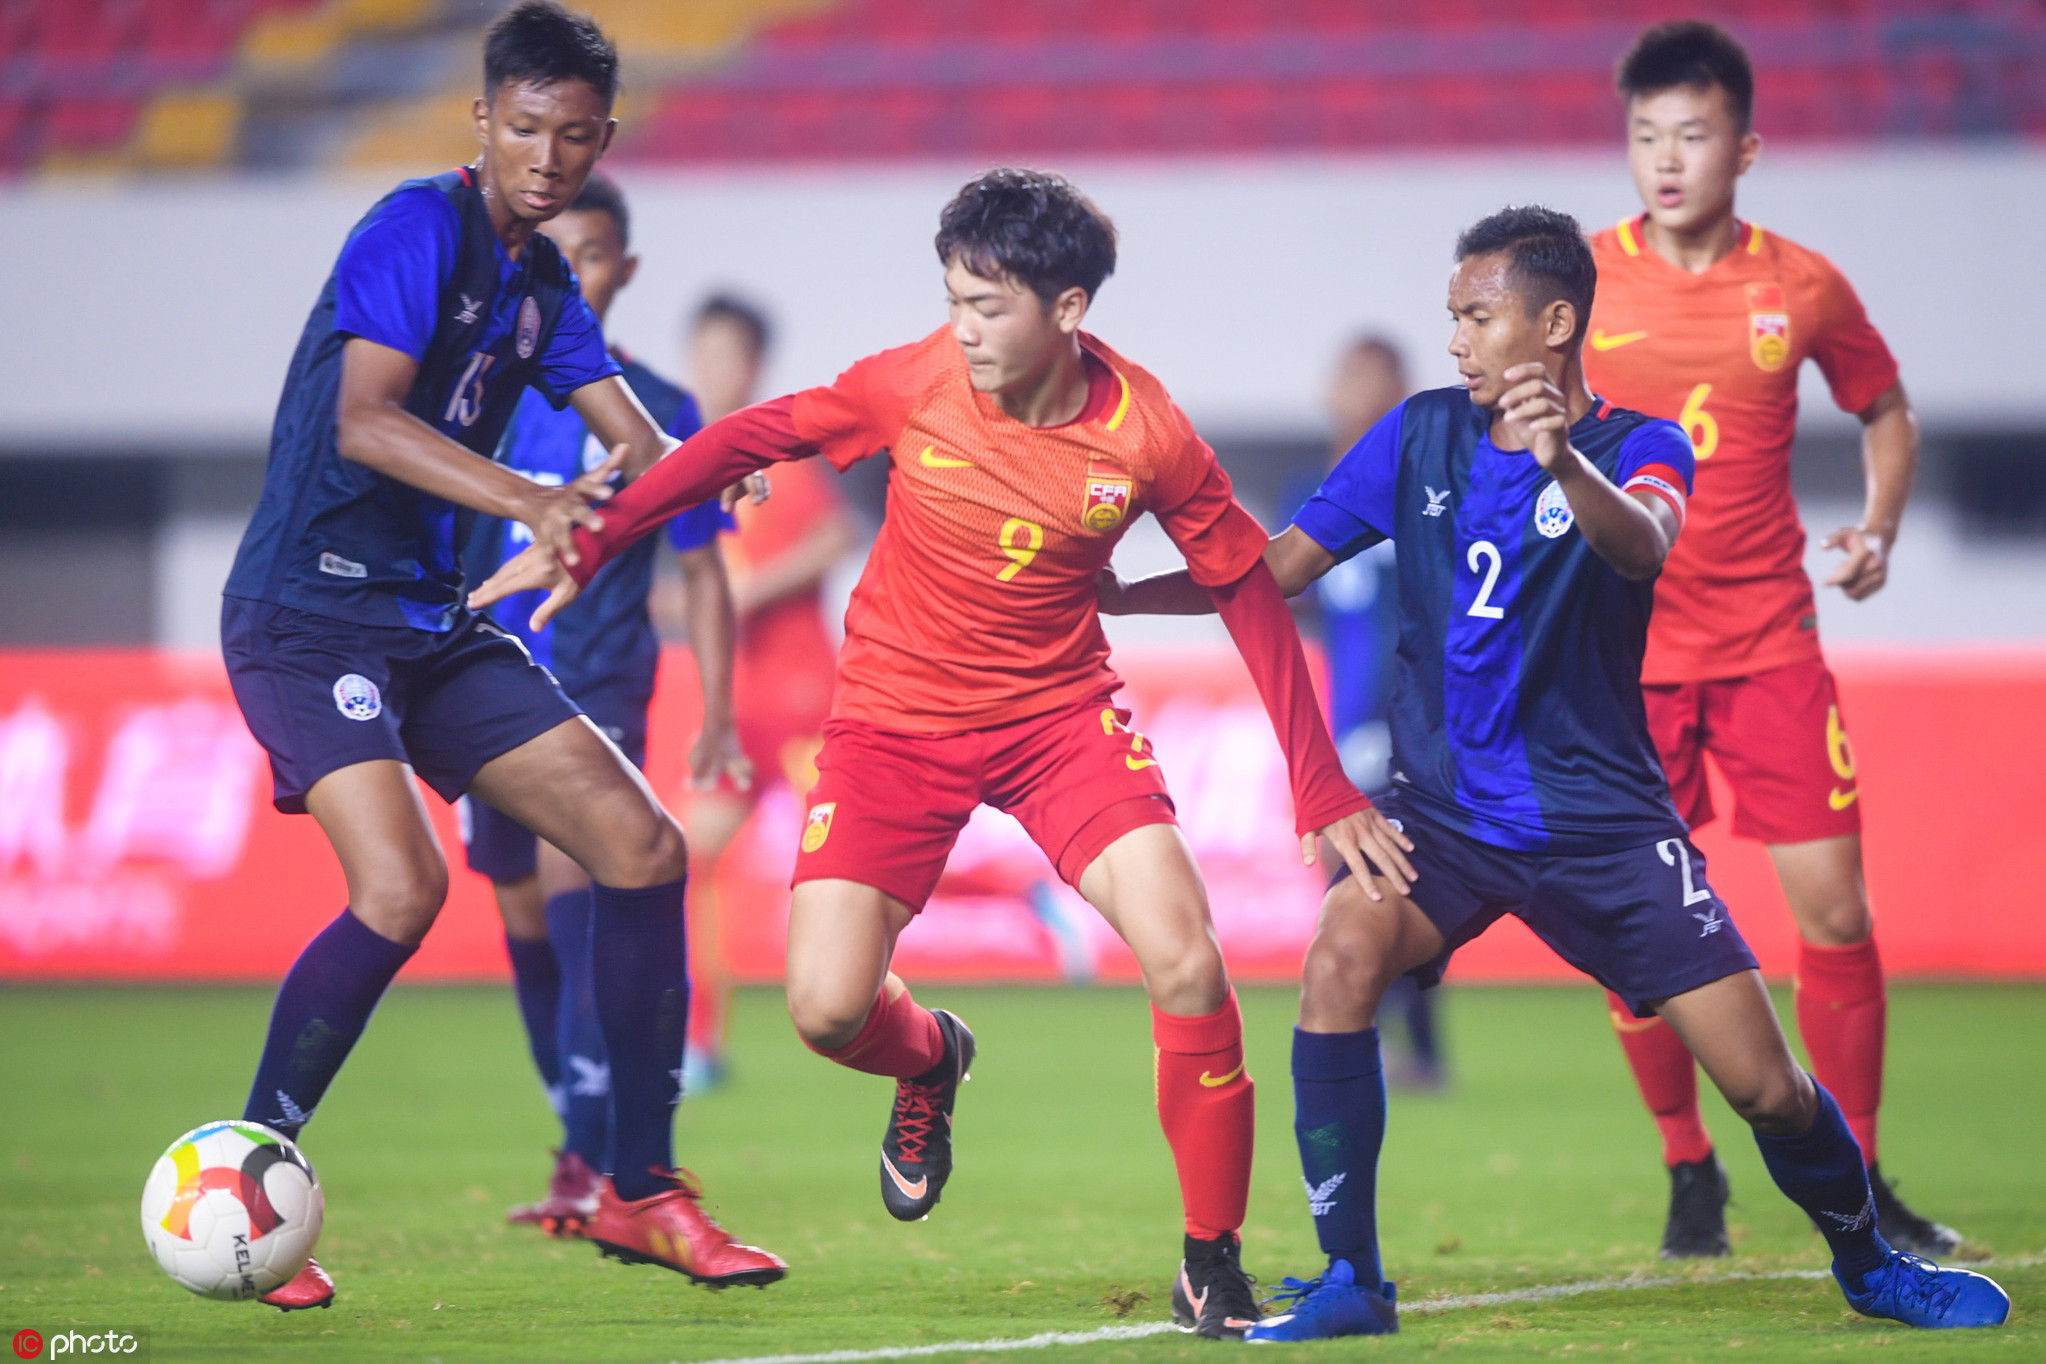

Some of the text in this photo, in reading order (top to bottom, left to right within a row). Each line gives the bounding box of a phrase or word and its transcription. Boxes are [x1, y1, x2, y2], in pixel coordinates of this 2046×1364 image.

[1679, 383, 1719, 461] 6
[1090, 483, 1127, 498] CFA
[995, 516, 1043, 582] 9
[1467, 540, 1504, 619] 2
[1827, 704, 1856, 774] 6
[1656, 838, 1712, 908] 2
